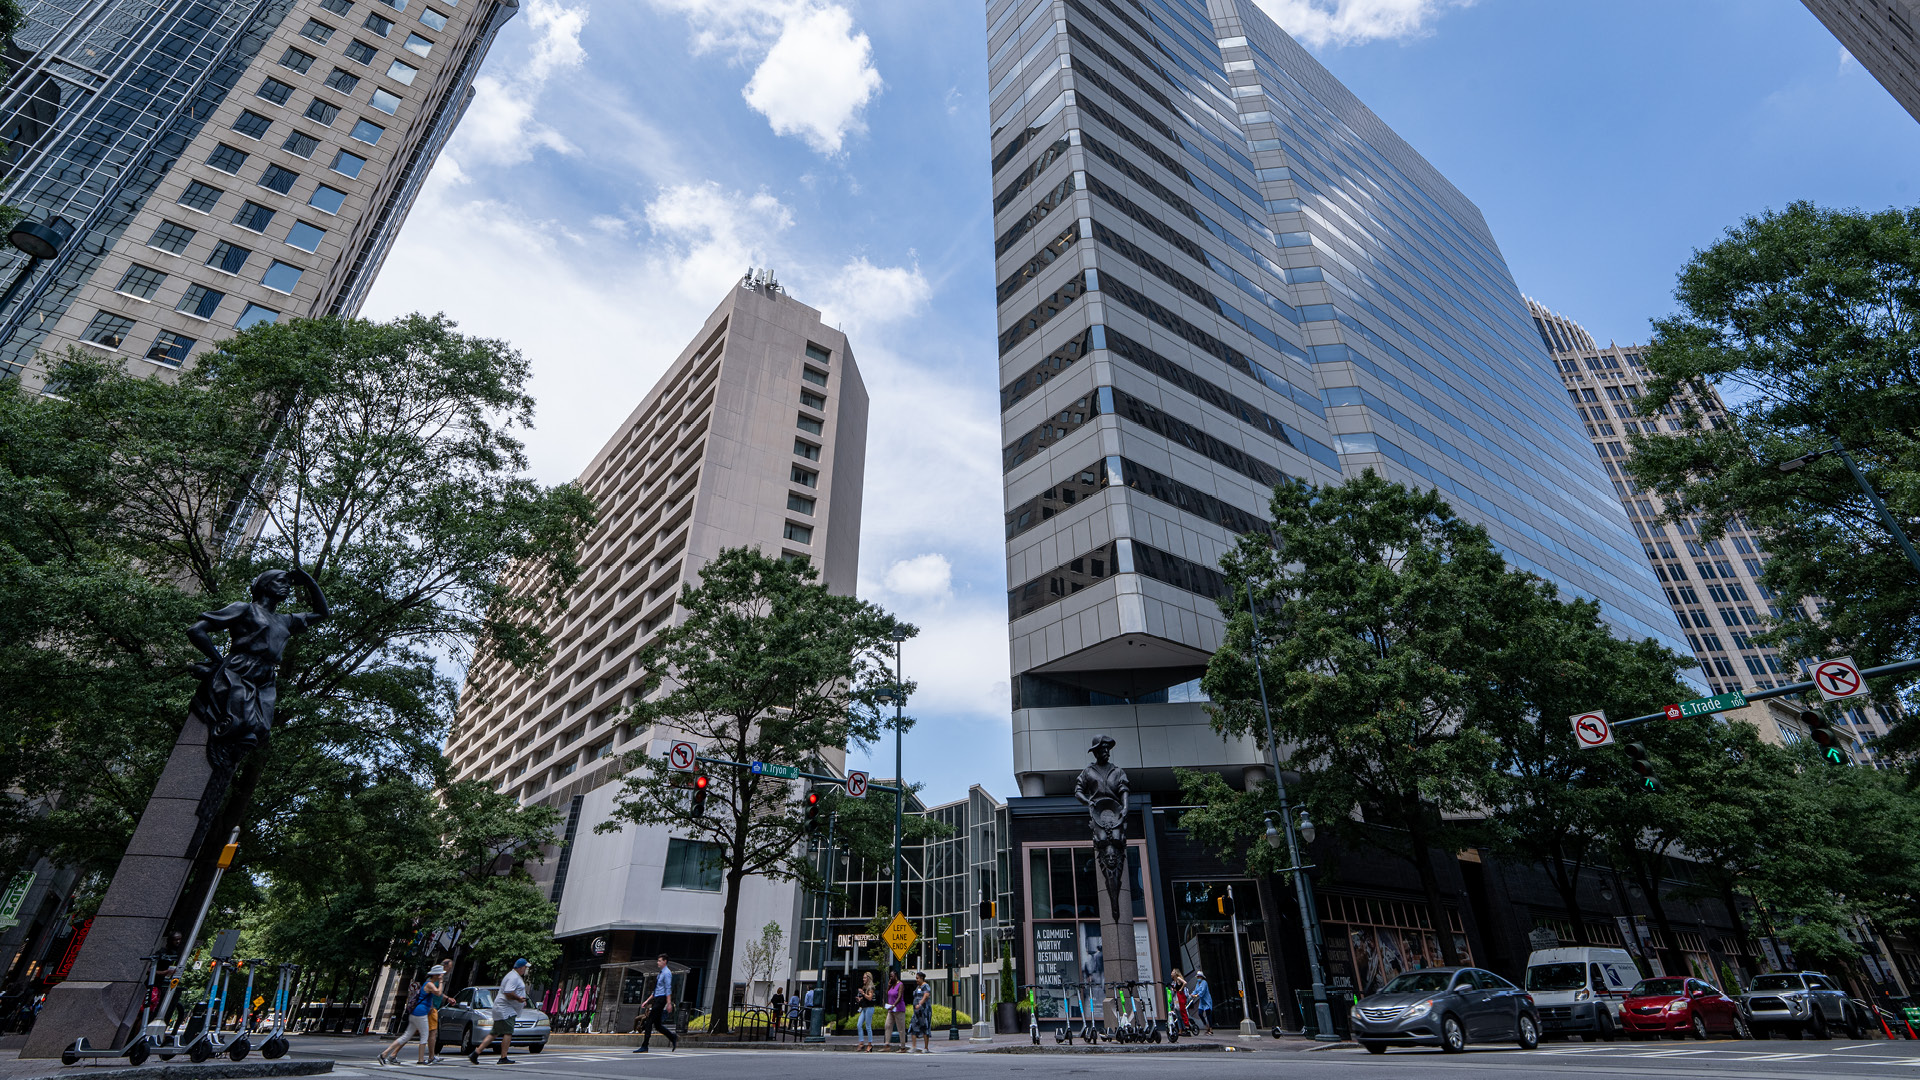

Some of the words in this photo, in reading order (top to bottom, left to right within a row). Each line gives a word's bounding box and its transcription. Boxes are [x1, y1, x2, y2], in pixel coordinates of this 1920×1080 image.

[1733, 692, 1740, 700] St
[1680, 705, 1692, 716] E.
[1690, 699, 1722, 714] Trade
[1731, 699, 1745, 707] 100
[762, 763, 769, 772] N.
[770, 764, 787, 776] Tryon
[1037, 929, 1042, 939] A
[1043, 929, 1073, 938] COMMUTE-
[838, 934, 852, 947] ONE
[1037, 941, 1060, 950] WORTHY
[1250, 940, 1268, 955] ONE
[1038, 952, 1073, 961] DESTINATION
[1038, 964, 1045, 973] IN
[1046, 963, 1057, 973] THE
[1253, 960, 1265, 983] CENTER
[1039, 975, 1062, 985] MAKING
[1261, 960, 1276, 1004] INDEPENDENCE
